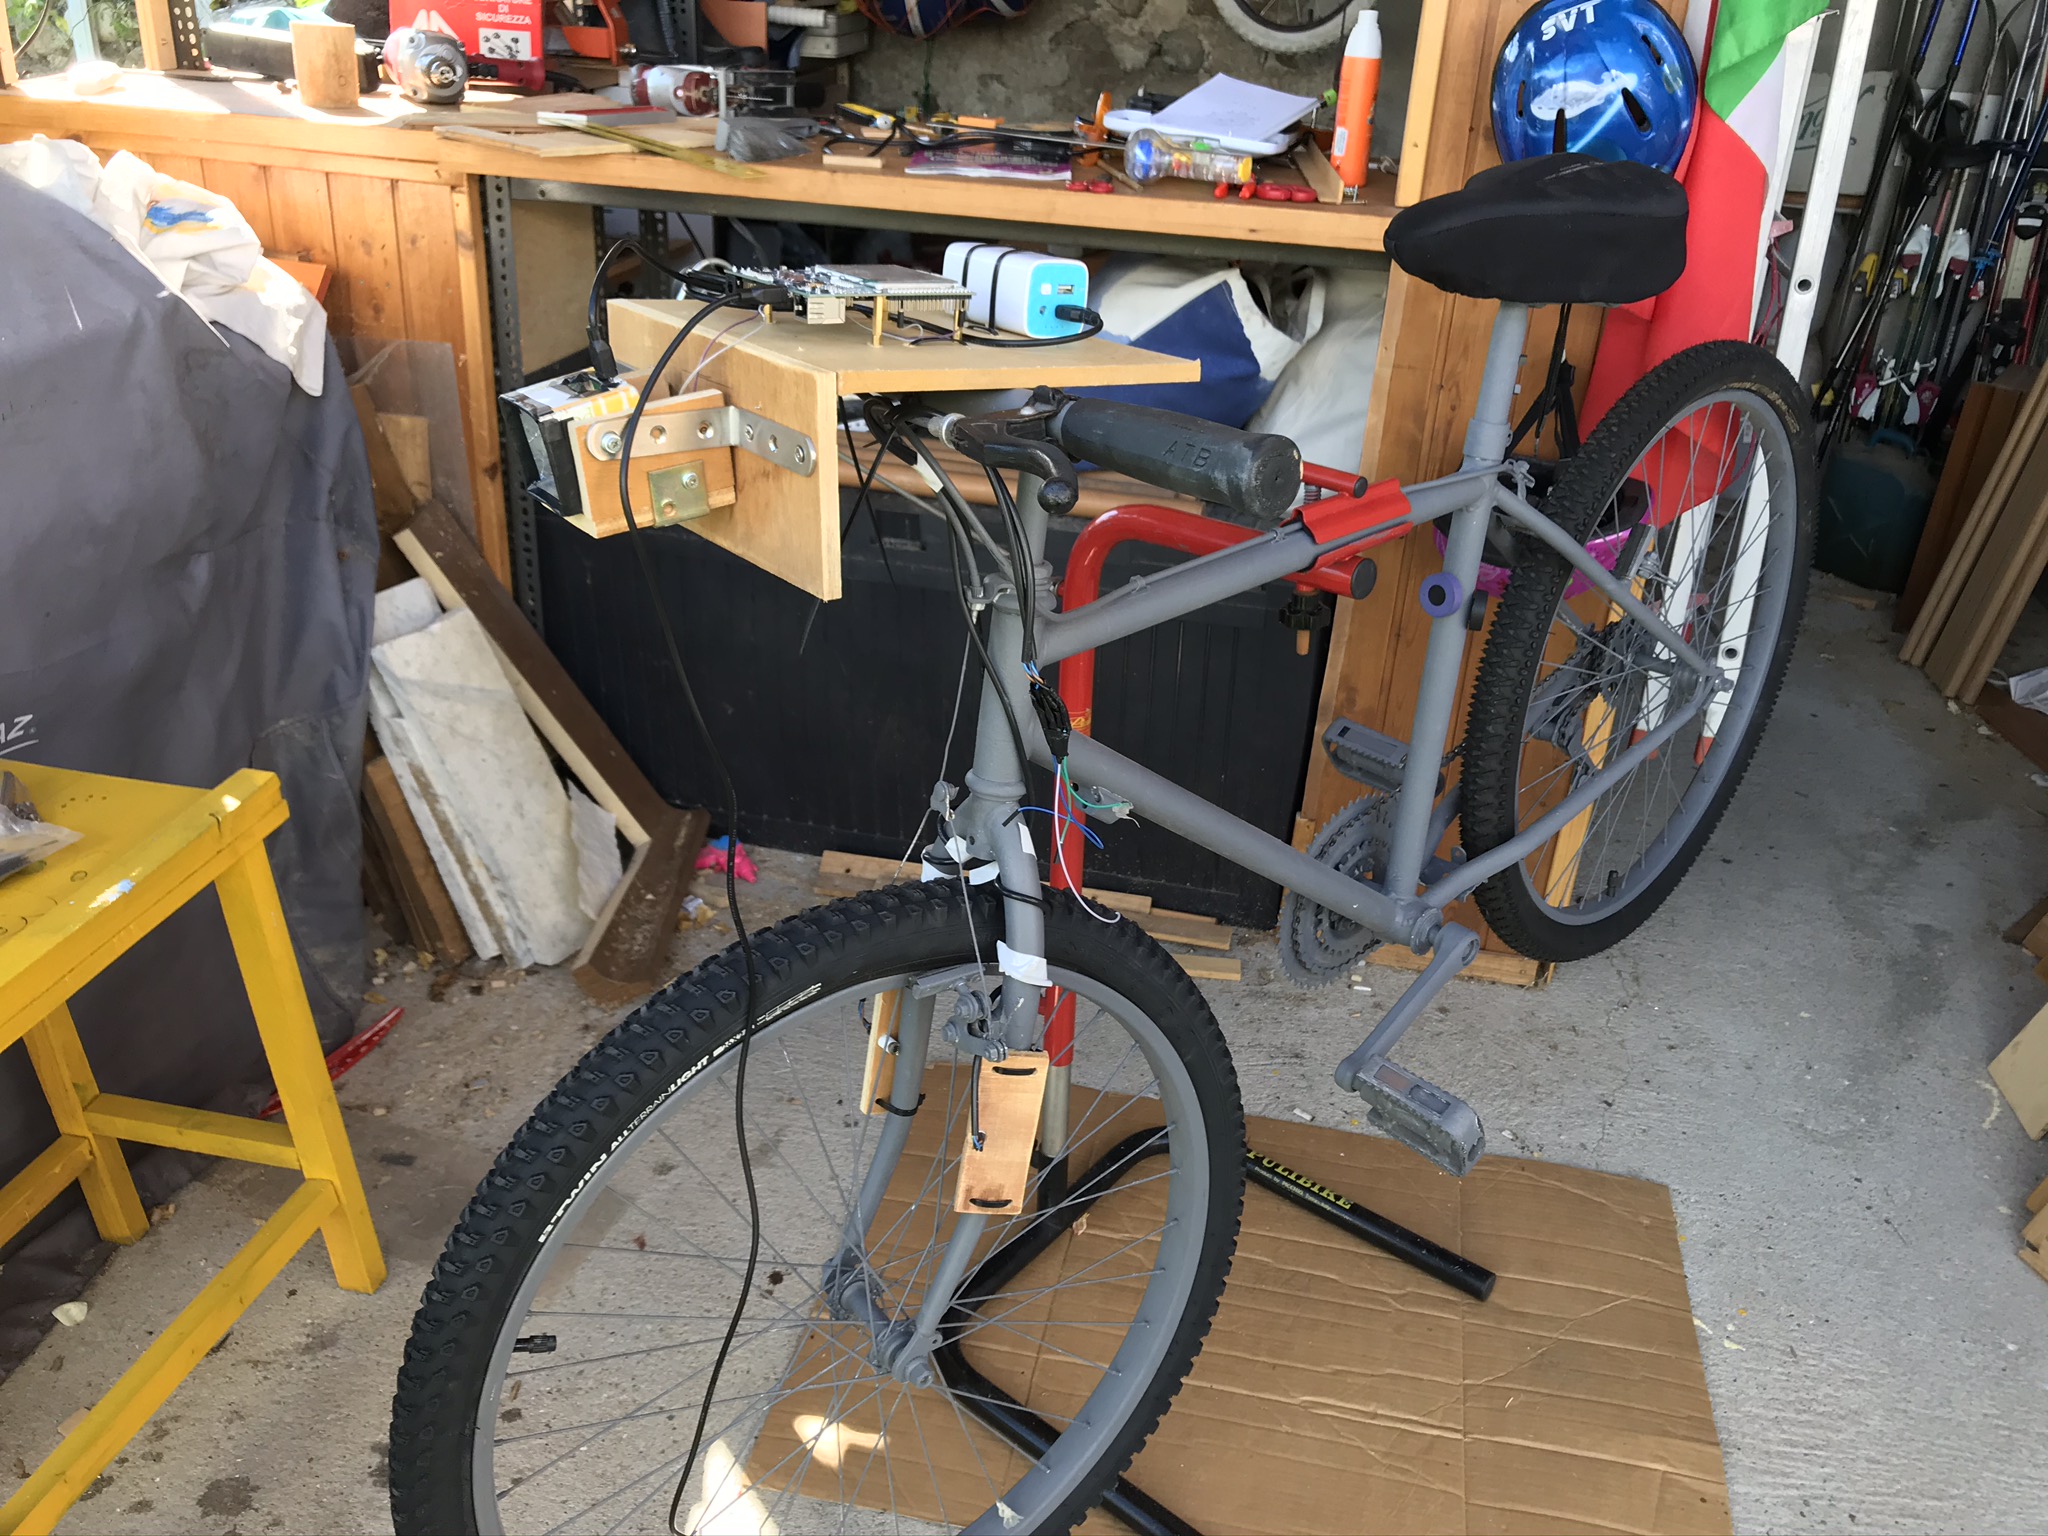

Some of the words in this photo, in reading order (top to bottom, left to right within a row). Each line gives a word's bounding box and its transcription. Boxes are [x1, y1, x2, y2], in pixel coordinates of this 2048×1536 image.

[475, 12, 532, 25] SICUREZZA
[498, 4, 509, 13] DI
[1541, 0, 1601, 41] SVT
[1163, 440, 1212, 468] ATB
